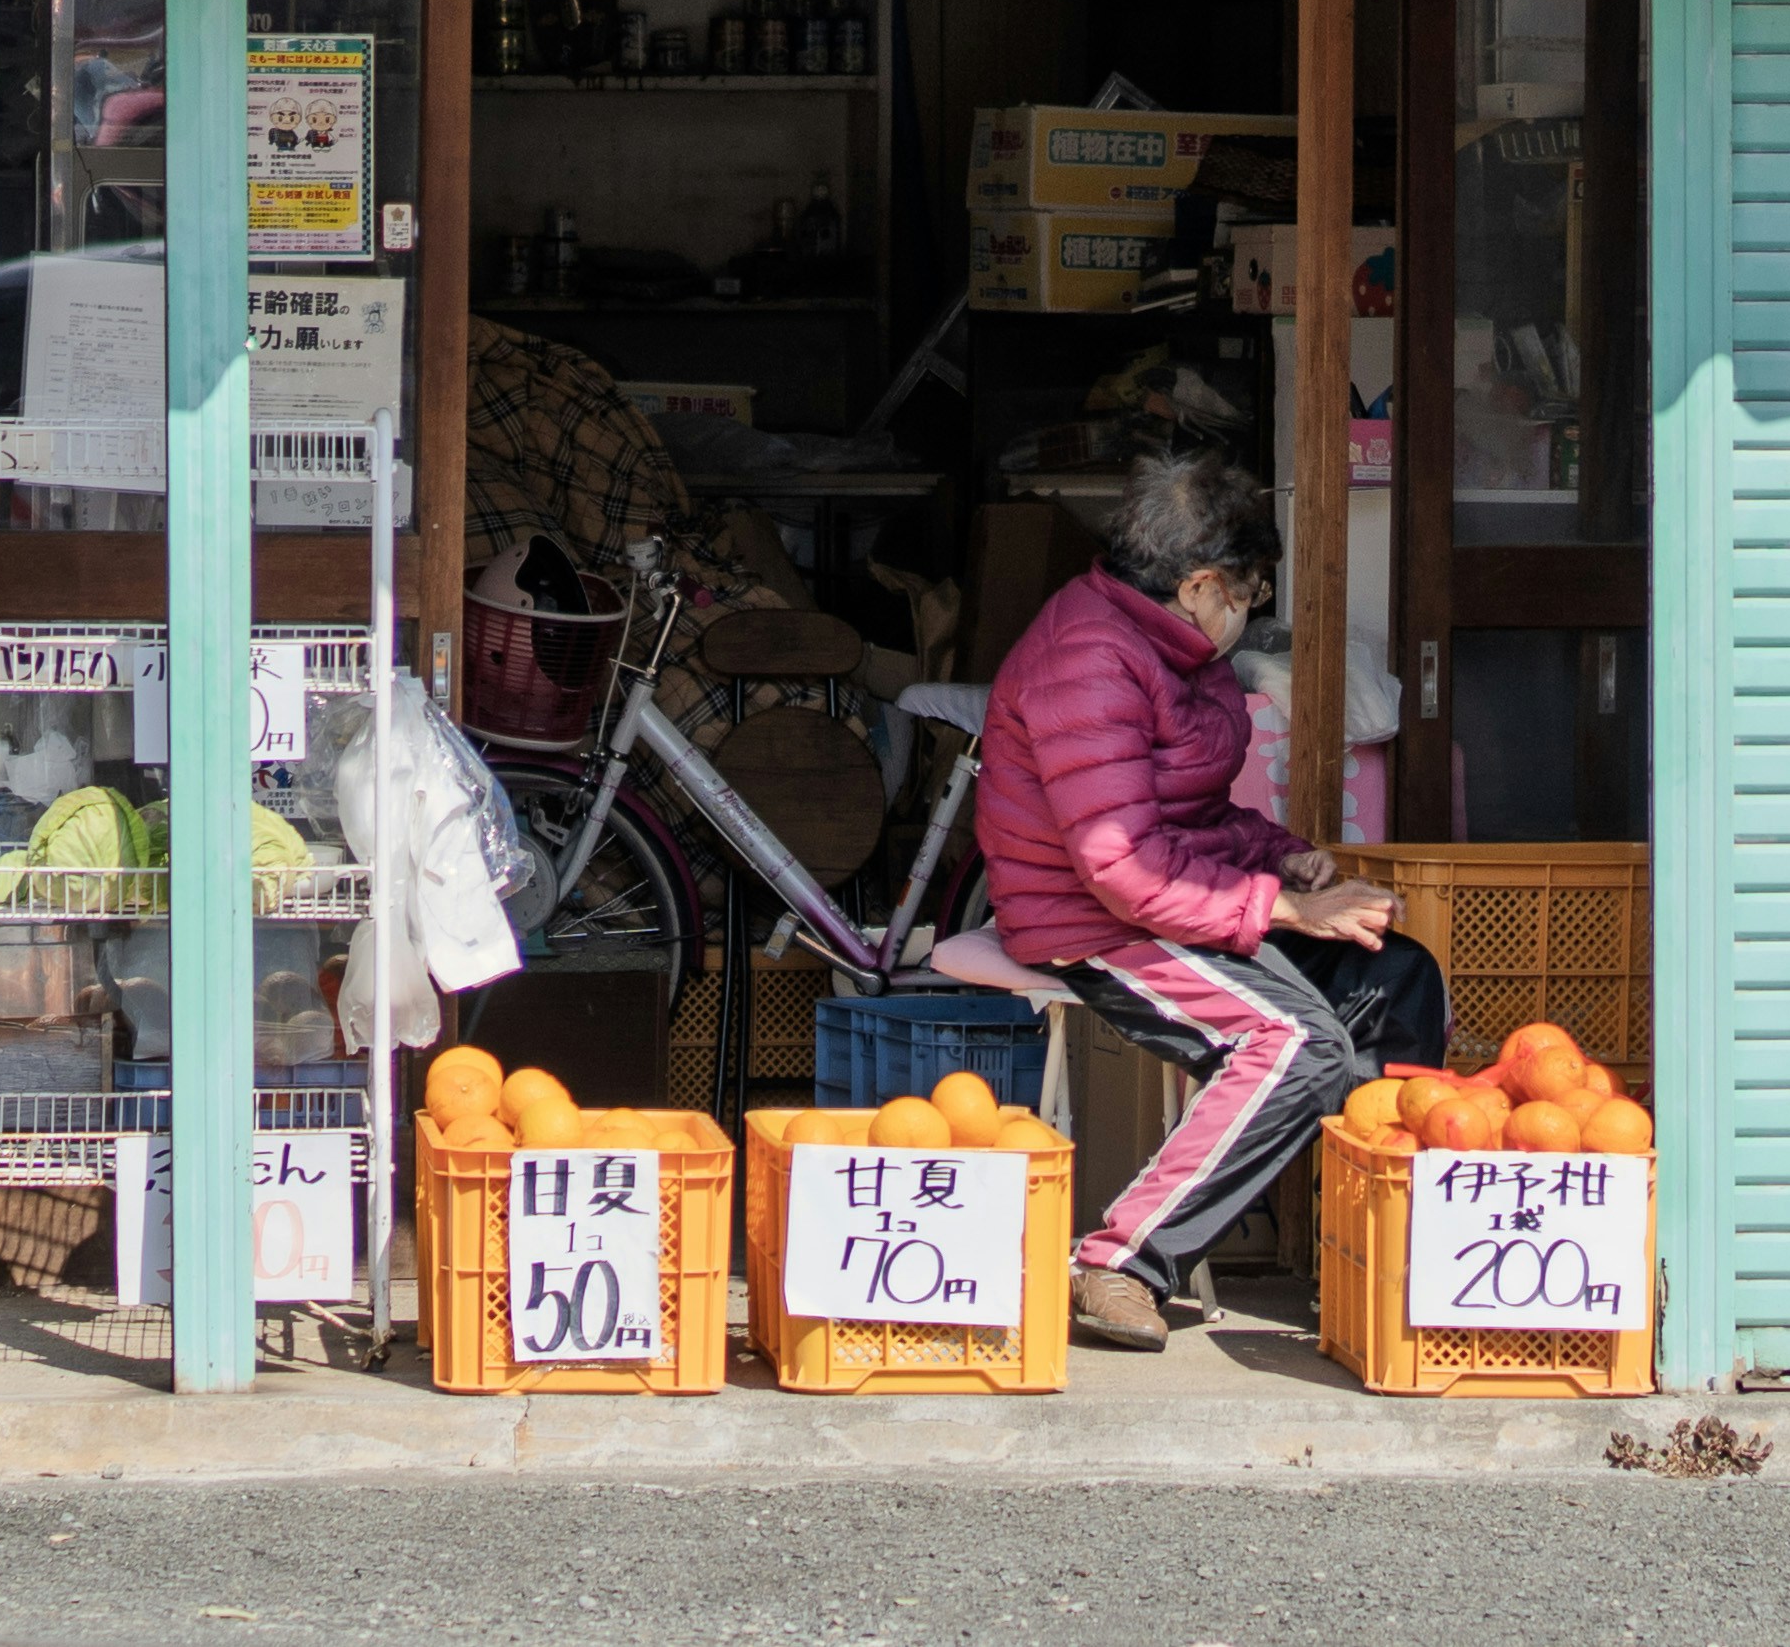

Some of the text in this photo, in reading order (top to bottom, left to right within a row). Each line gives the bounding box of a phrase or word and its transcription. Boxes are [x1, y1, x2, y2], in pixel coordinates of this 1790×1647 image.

[300, 39, 337, 52] 天心会
[1052, 130, 1164, 165] 植物在中
[514, 1154, 650, 1217] 甘夏
[834, 1155, 966, 1210] 甘夏
[1436, 1159, 1615, 1210] 伊予柑
[565, 1221, 603, 1253] 1コ
[874, 1210, 918, 1233] 1コ
[839, 1235, 977, 1305] 70円
[1450, 1237, 1621, 1316] 200円
[522, 1259, 652, 1353] 50円
